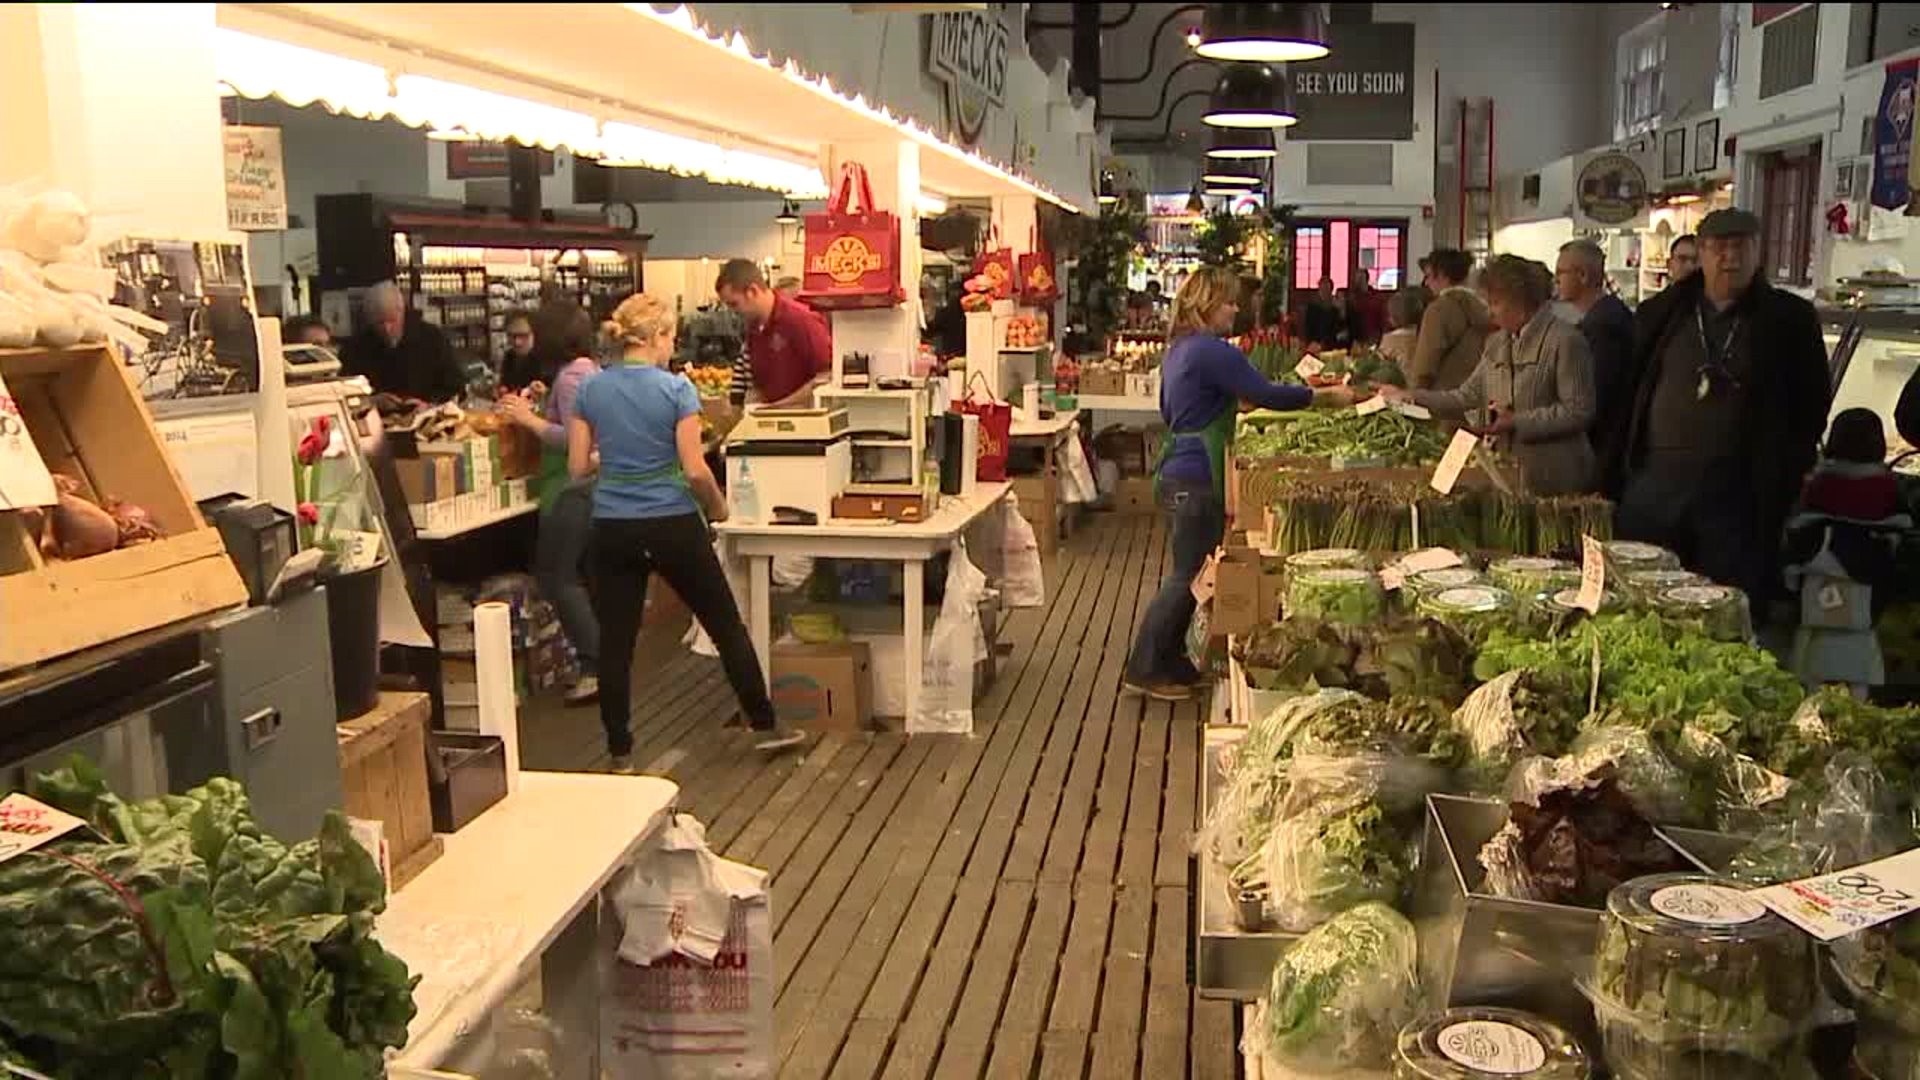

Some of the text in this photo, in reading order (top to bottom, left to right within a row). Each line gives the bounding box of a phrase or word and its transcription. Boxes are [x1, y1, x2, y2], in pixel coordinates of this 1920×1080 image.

[1296, 72, 1404, 94] SEE YOU SOON
